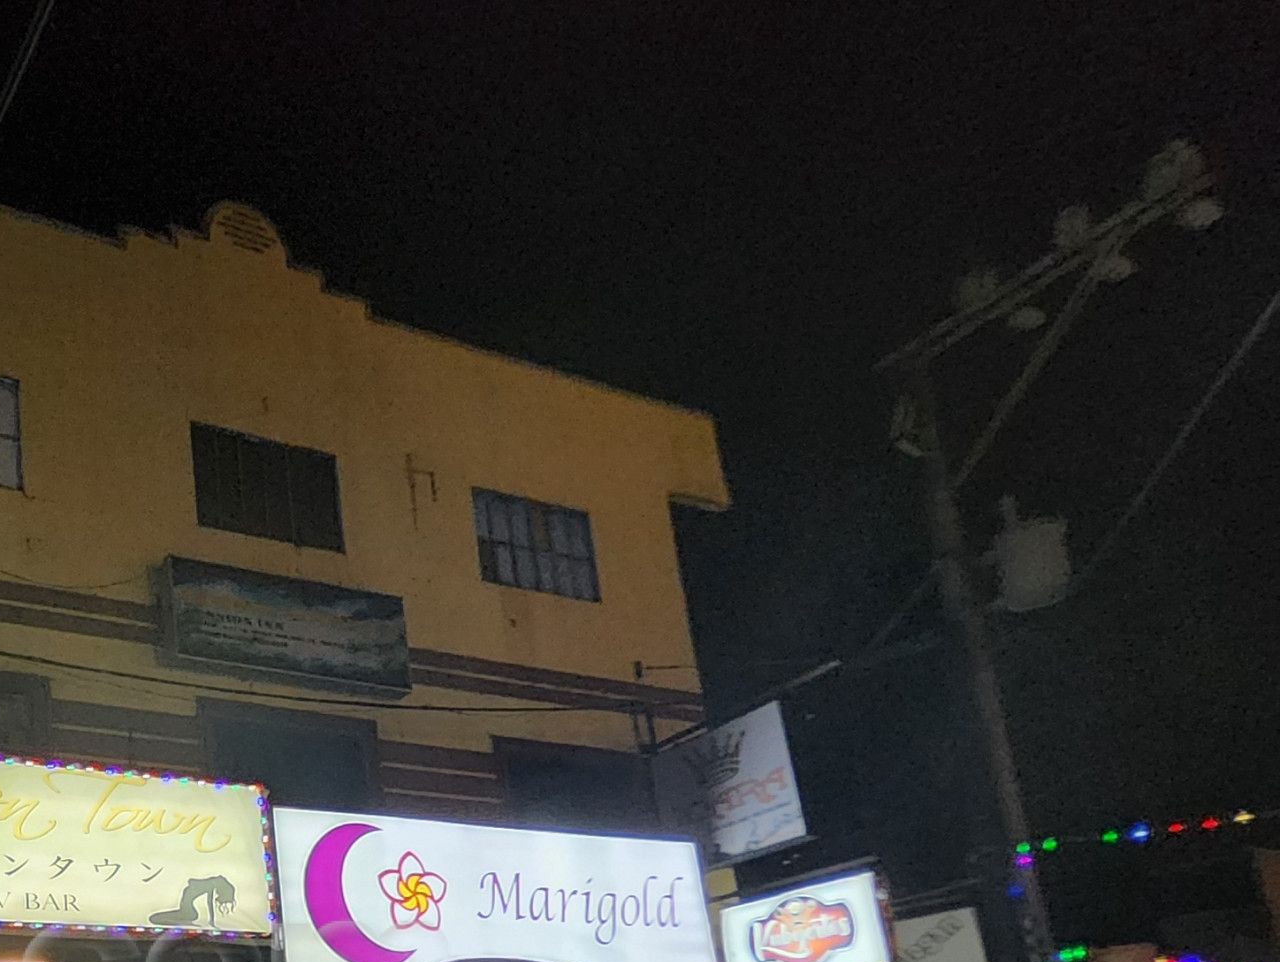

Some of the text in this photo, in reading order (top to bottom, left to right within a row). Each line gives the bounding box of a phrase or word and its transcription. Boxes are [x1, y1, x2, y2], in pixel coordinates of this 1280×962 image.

[42, 770, 233, 853] Town
[24, 891, 81, 912] BAR
[477, 871, 684, 945] Marigold
